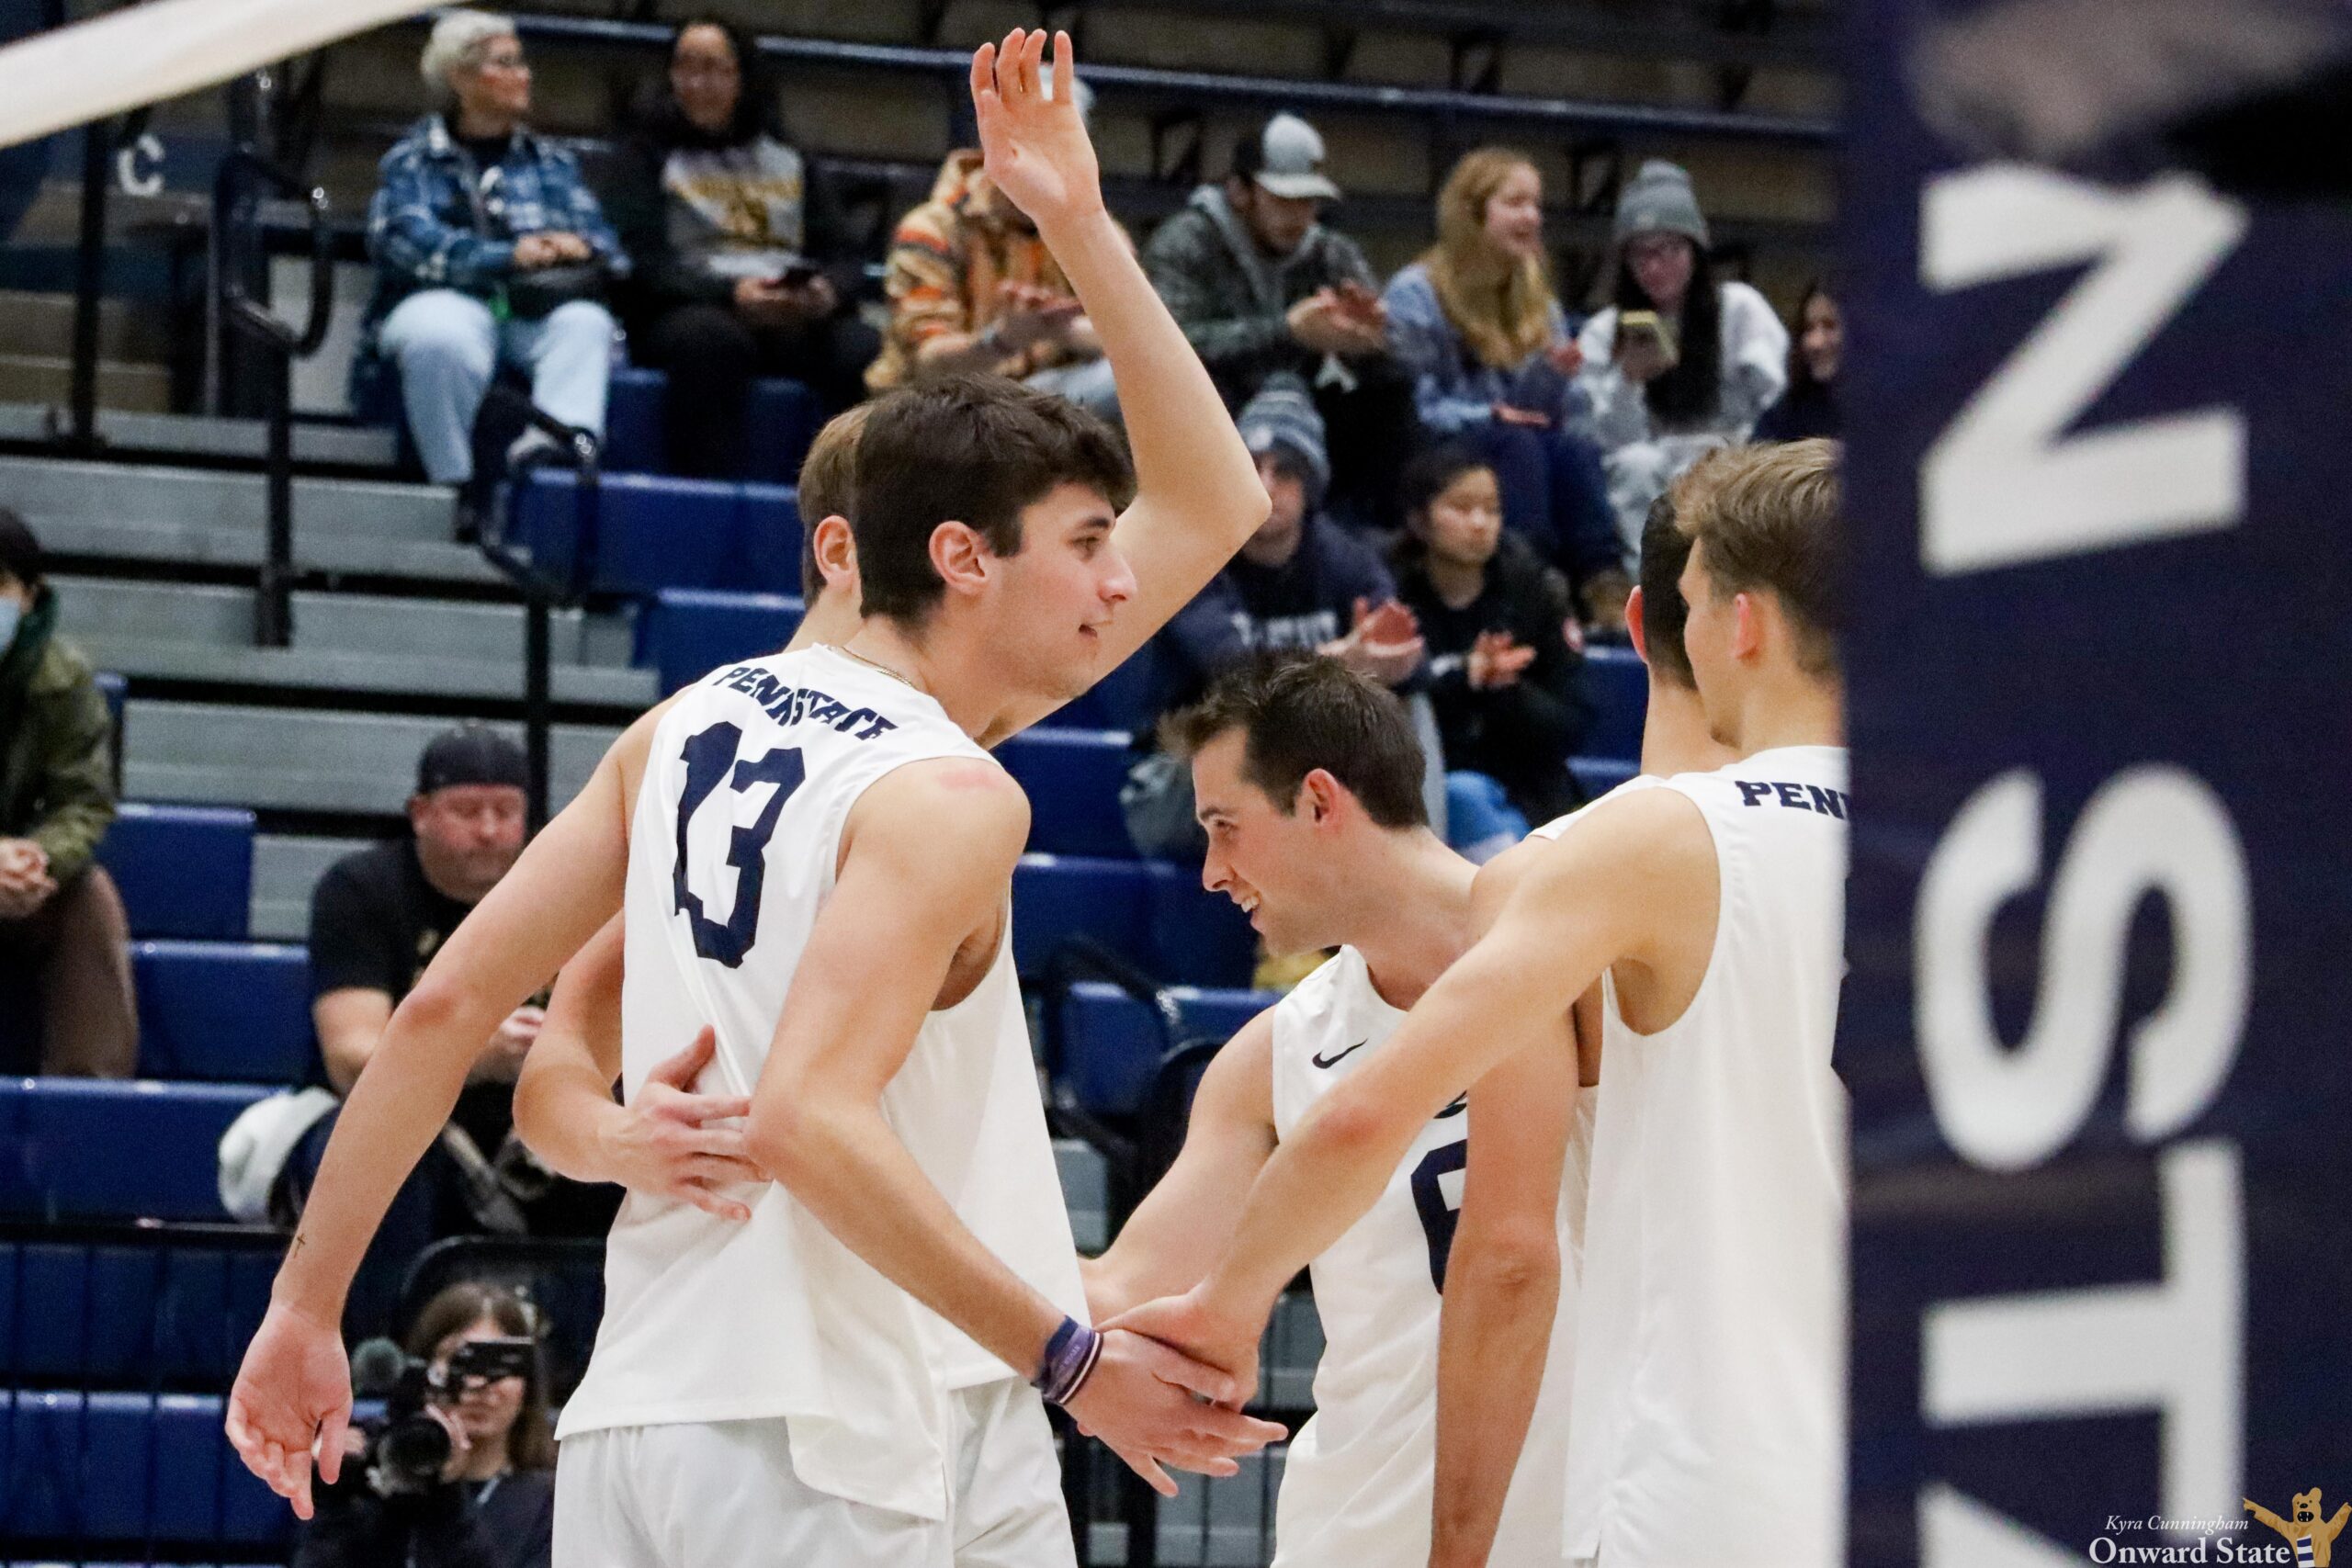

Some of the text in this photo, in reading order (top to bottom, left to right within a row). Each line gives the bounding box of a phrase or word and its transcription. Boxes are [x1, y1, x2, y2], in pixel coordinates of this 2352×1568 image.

[712, 667, 797, 727] PENN
[673, 721, 806, 969] 13
[1913, 761, 2253, 1568] ST
